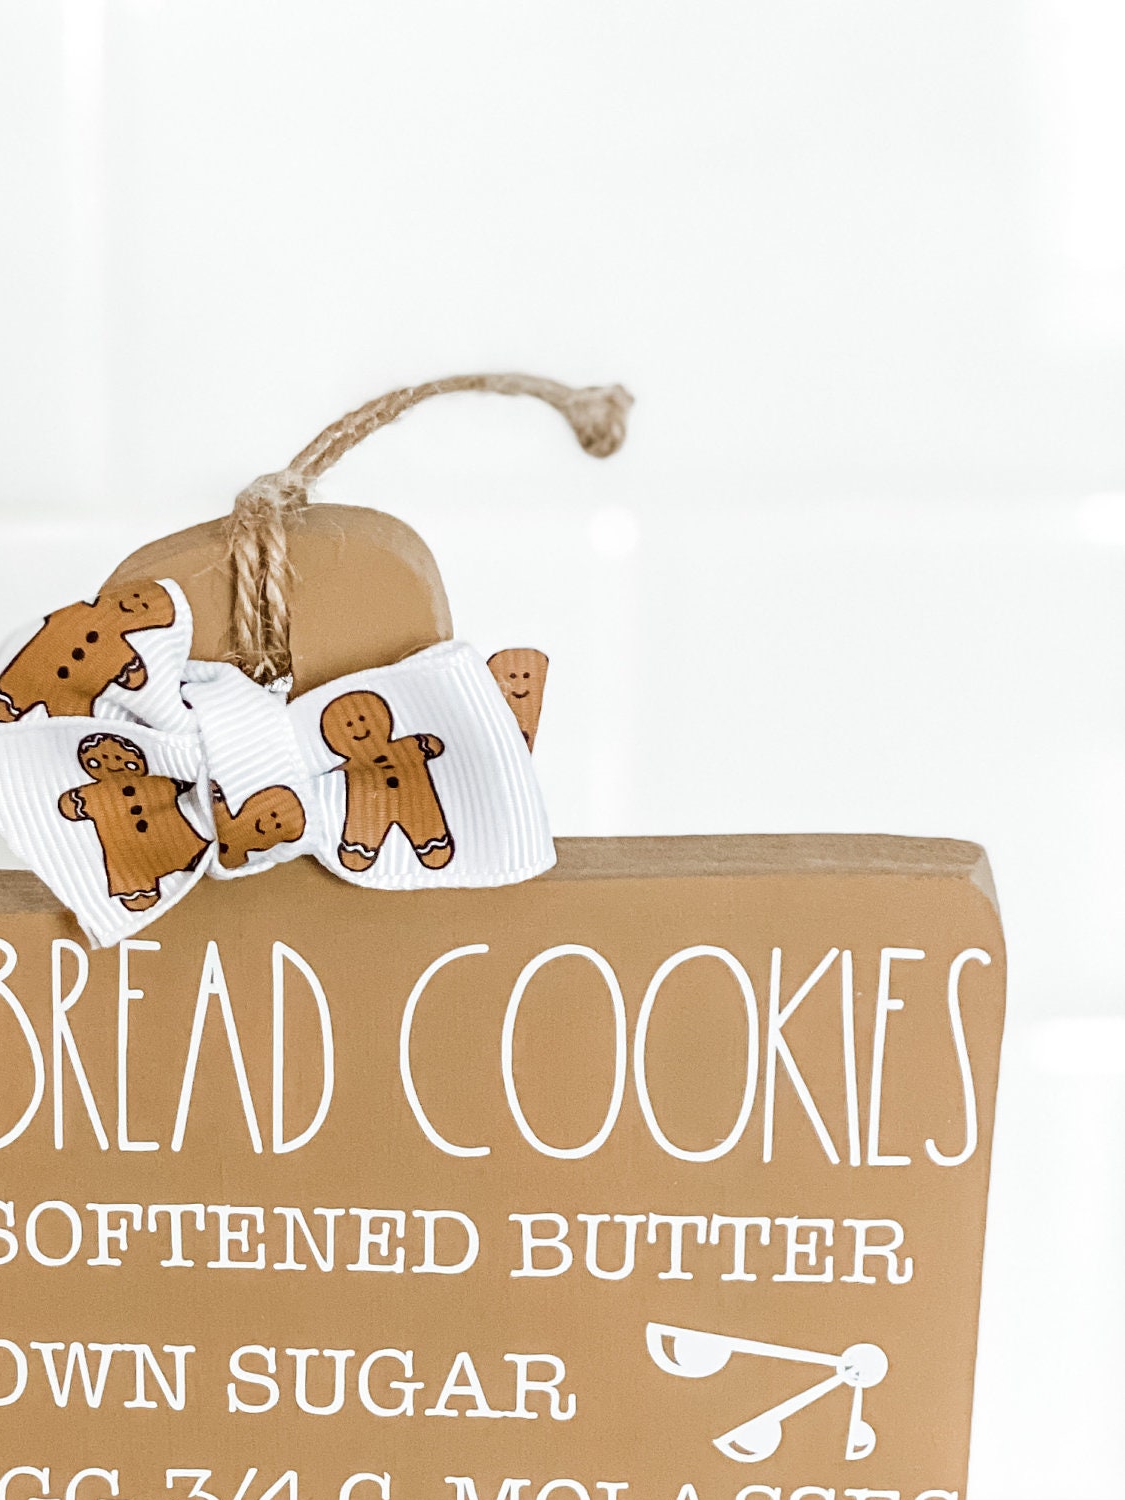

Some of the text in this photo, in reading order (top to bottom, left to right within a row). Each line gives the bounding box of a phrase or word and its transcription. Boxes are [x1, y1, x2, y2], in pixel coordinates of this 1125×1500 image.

[399, 943, 992, 1167] COOKIES
[510, 1214, 914, 1285] BUTTER
[228, 1346, 577, 1421] SUGAR
